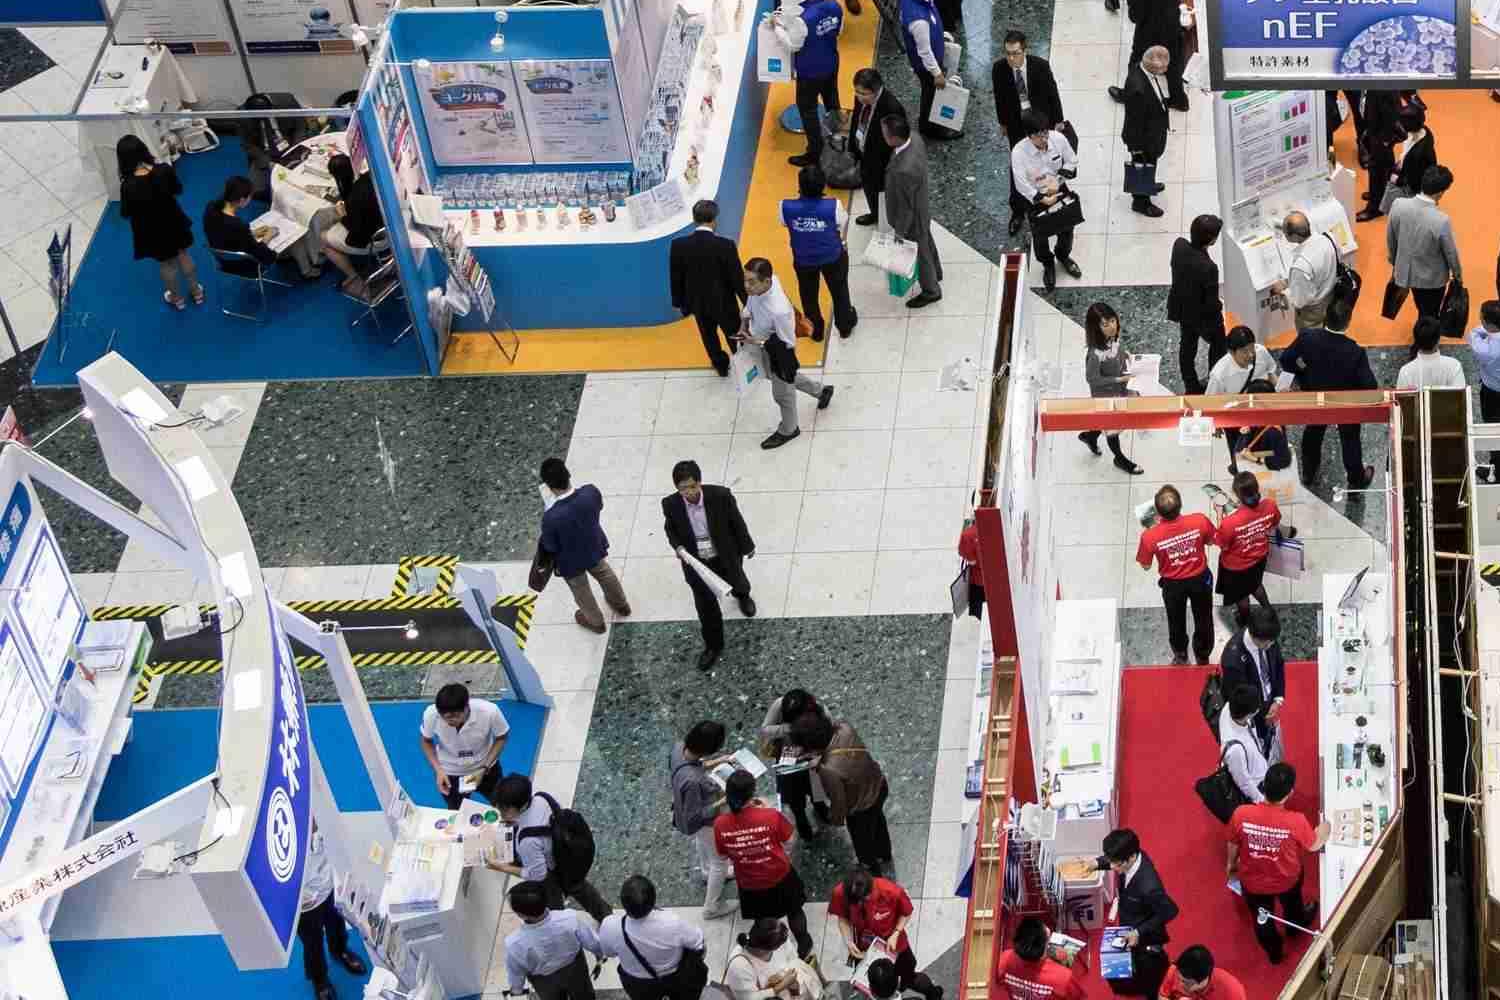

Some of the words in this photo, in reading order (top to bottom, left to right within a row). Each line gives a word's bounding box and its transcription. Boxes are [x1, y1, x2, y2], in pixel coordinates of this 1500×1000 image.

[1262, 11, 1339, 40] nEF
[1249, 55, 1311, 69] 特許素材
